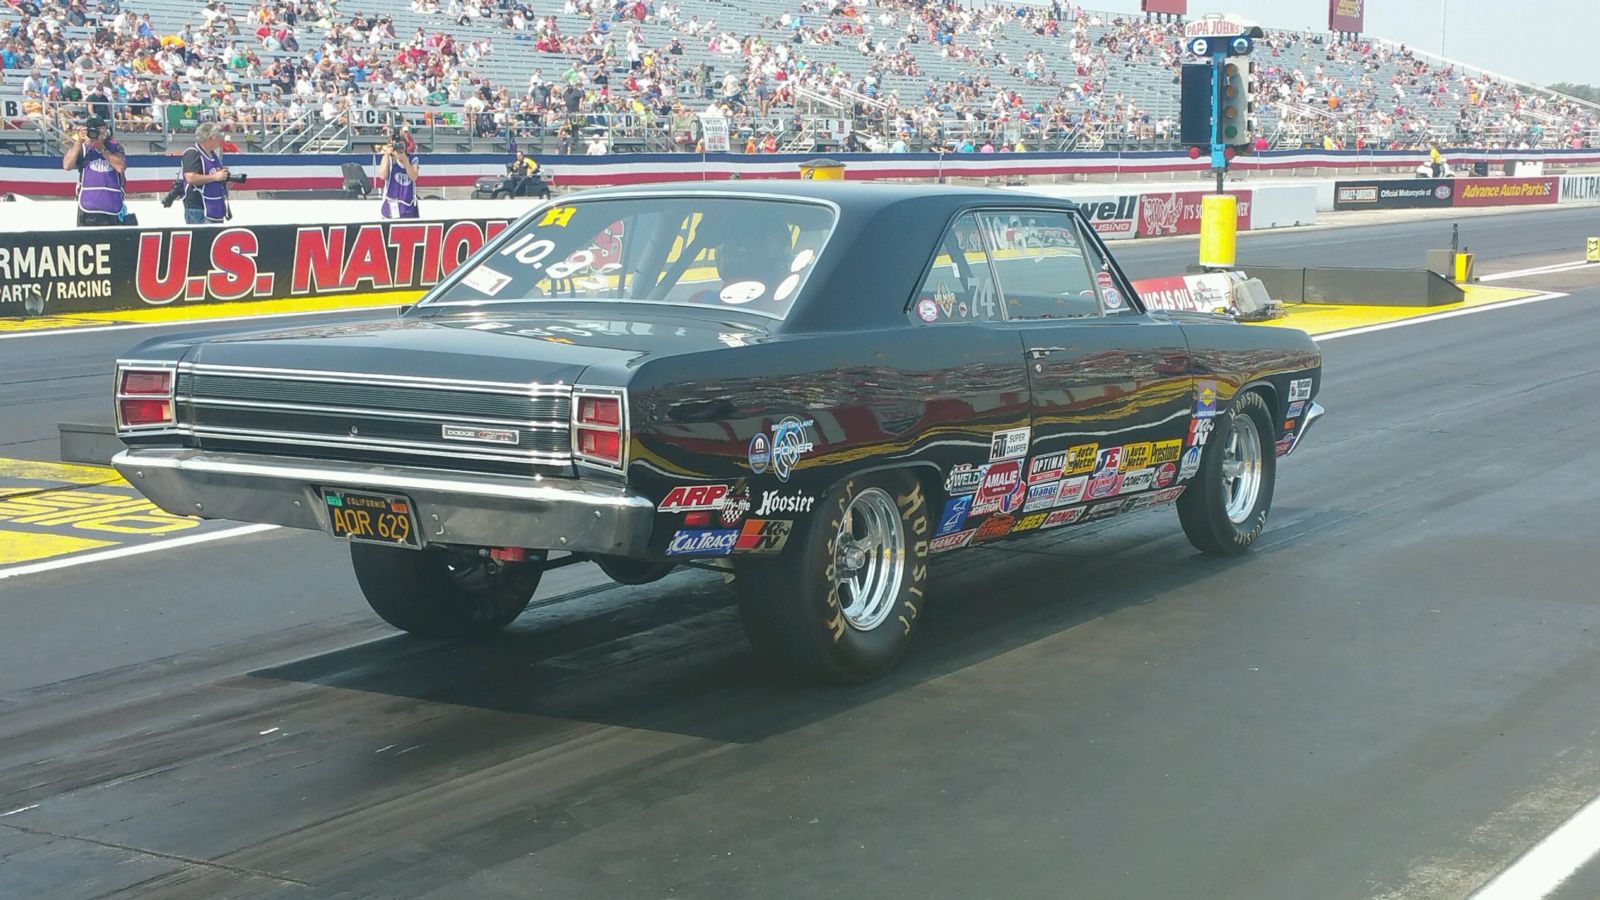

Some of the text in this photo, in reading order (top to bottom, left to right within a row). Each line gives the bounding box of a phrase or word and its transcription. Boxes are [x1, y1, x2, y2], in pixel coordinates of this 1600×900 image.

[1187, 22, 1209, 35] PAPA
[5, 101, 18, 116] B
[366, 110, 377, 125] C
[625, 115, 633, 128] D
[1462, 183, 1544, 199] Advance Auto Parts
[538, 206, 577, 228] H
[135, 229, 275, 304] U.S.
[0, 283, 42, 303] ARTS
[57, 280, 112, 299] RACING
[967, 277, 996, 318] 74
[1173, 288, 1194, 310] OIL
[1009, 432, 1026, 442] SUPER
[1006, 443, 1028, 454] DAMPER
[1151, 443, 1180, 462] Prestone
[1032, 453, 1066, 474] OPTIMA
[953, 471, 980, 487] WELD
[983, 469, 1018, 489] AMALIE
[346, 497, 387, 509] CALIFORNIA
[660, 485, 727, 508] ARP
[755, 489, 815, 516] Hoosier
[333, 507, 410, 541] AQR 629
